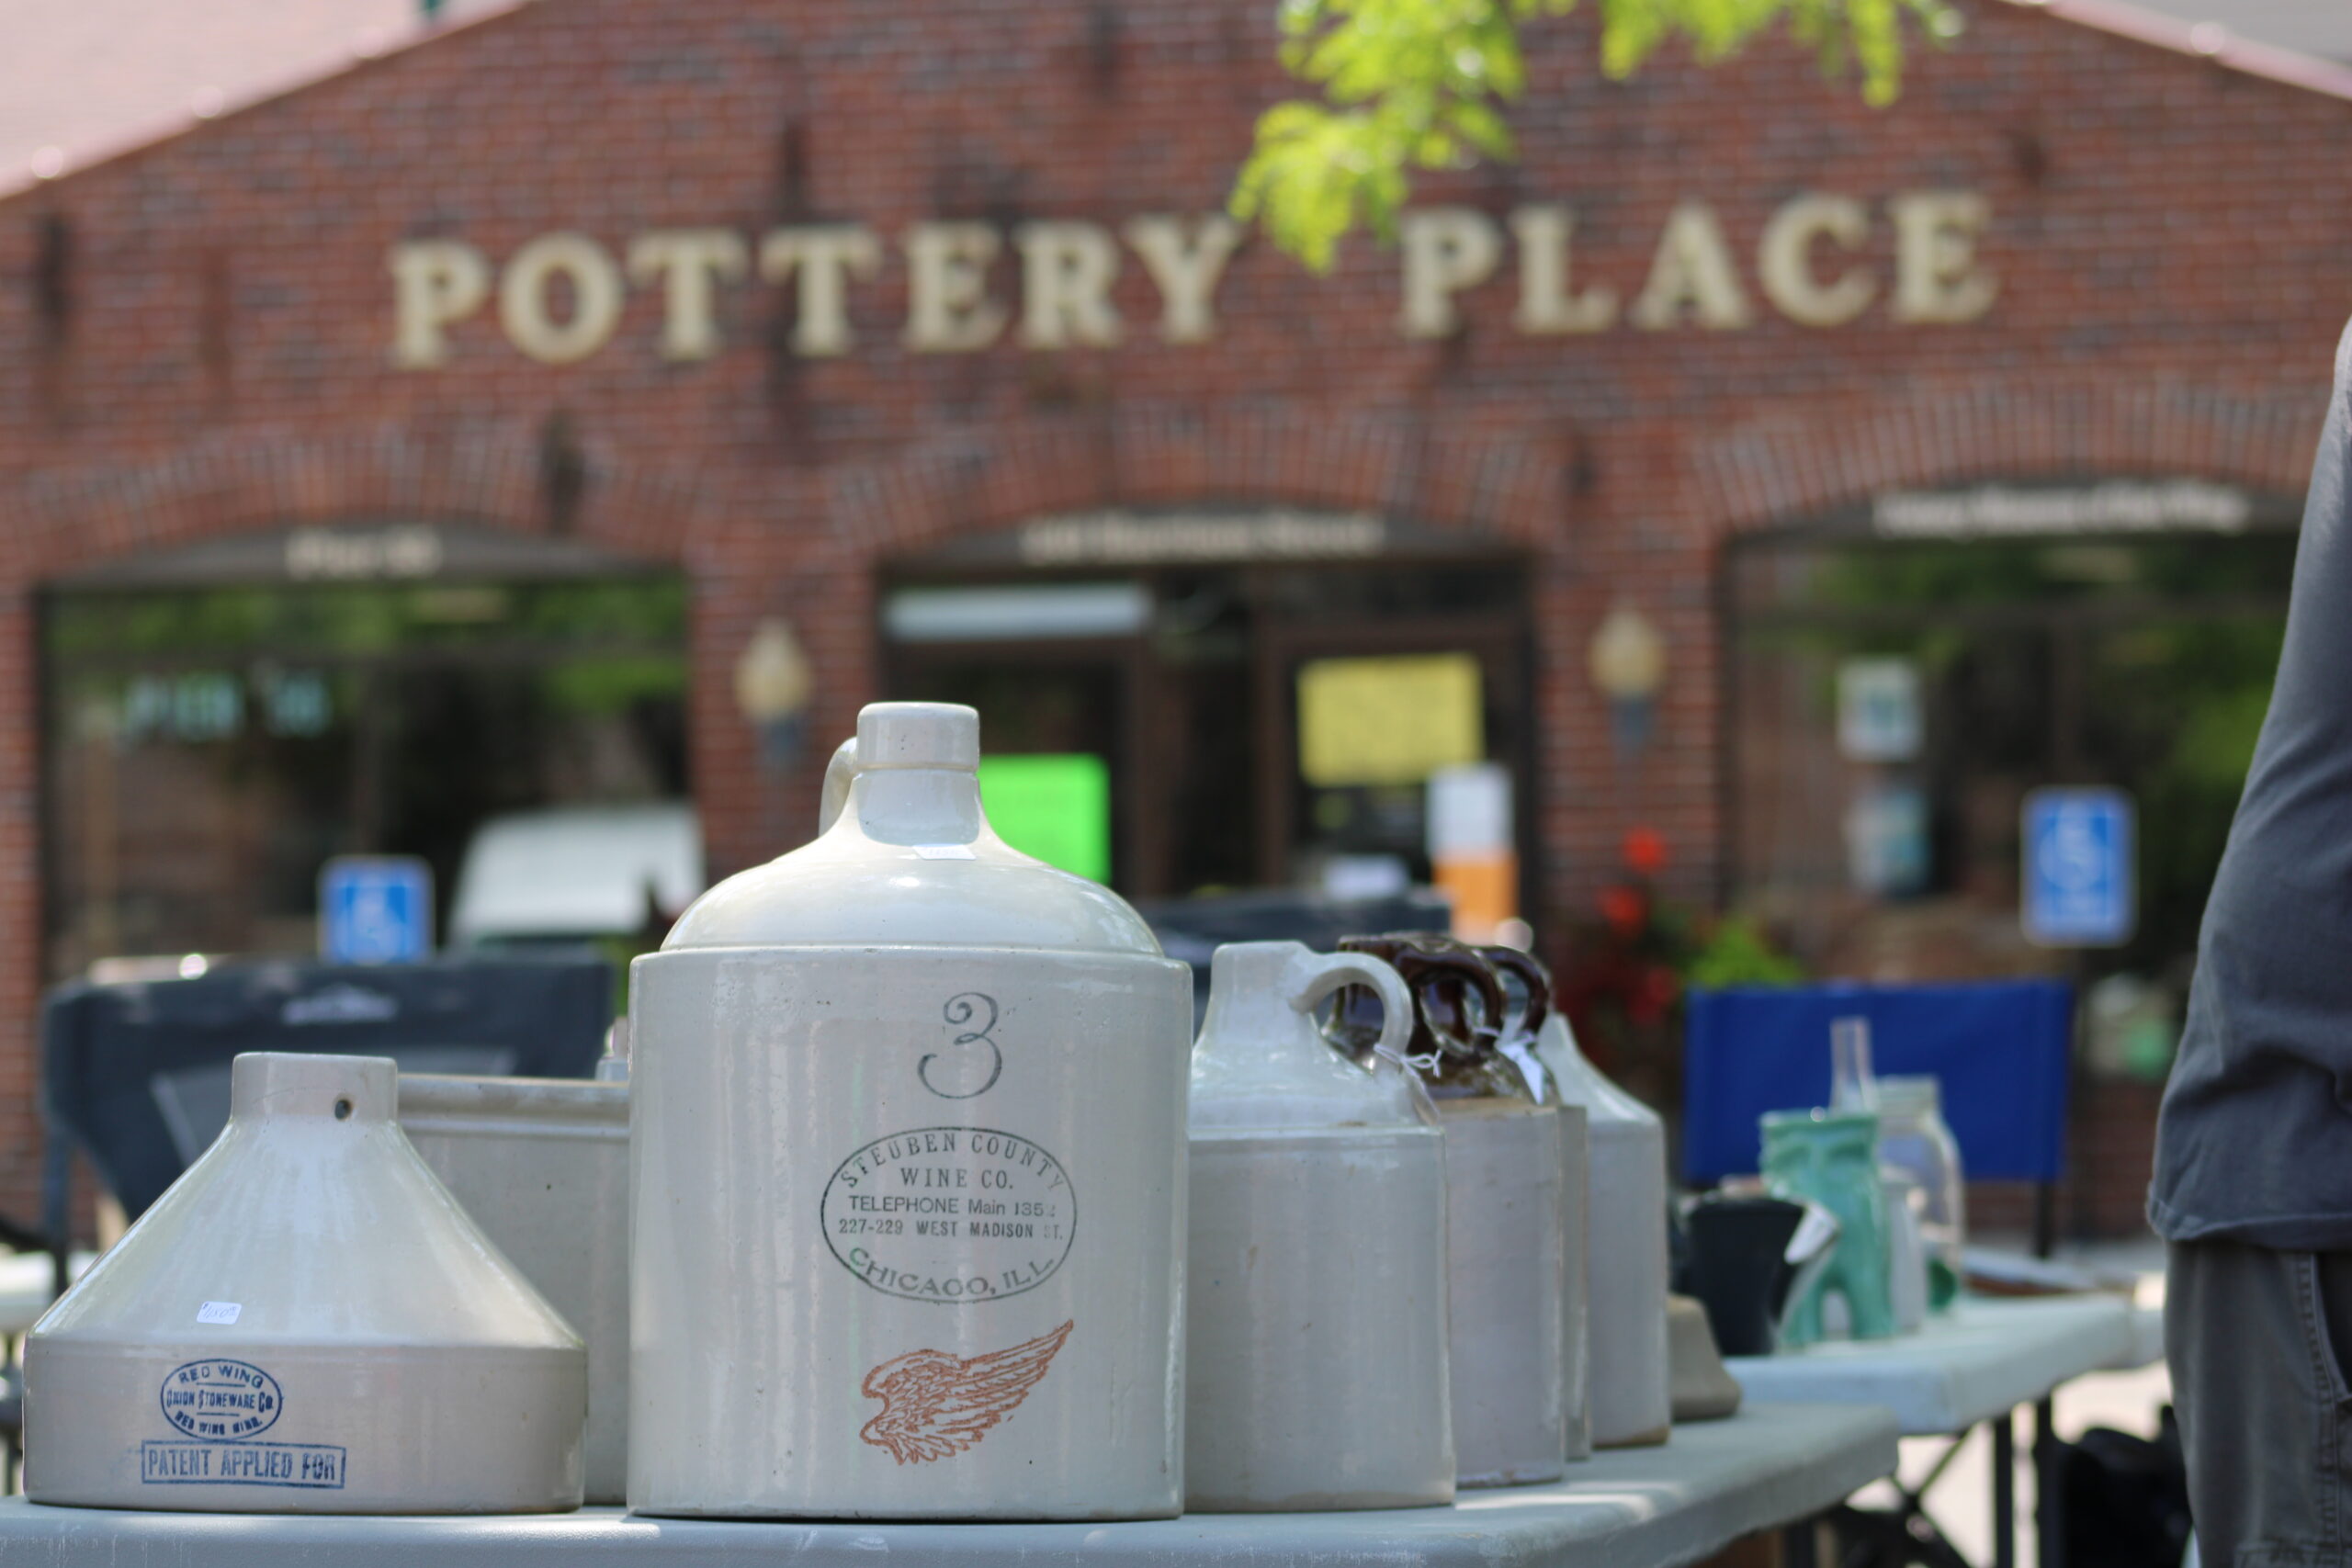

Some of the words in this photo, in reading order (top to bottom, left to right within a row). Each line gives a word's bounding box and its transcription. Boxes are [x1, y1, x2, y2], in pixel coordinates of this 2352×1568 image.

[392, 216, 1242, 366] POTTERY
[1400, 193, 2001, 338] PLACE
[918, 991, 1002, 1100] 3
[840, 1133, 956, 1190] STEUBEN
[971, 1133, 1065, 1191] COUNTY
[900, 1168, 967, 1188] WINE
[980, 1169, 1013, 1190] CO.
[849, 1195, 959, 1214] TELEPHONE
[968, 1199, 1005, 1215] Main
[839, 1219, 903, 1236] 227-229
[916, 1220, 957, 1237] WEST
[969, 1222, 1034, 1238] MADISON
[849, 1247, 996, 1297] CHICAGO,
[1001, 1258, 1056, 1290] ILL.
[178, 1365, 210, 1383] RED
[219, 1365, 264, 1389] WING
[166, 1389, 195, 1408] UNION
[198, 1389, 255, 1410] STONEWARE
[175, 1410, 195, 1430] RED
[148, 1449, 211, 1476] PATENT
[220, 1450, 292, 1479] APPLIED
[302, 1453, 335, 1481] FOR
